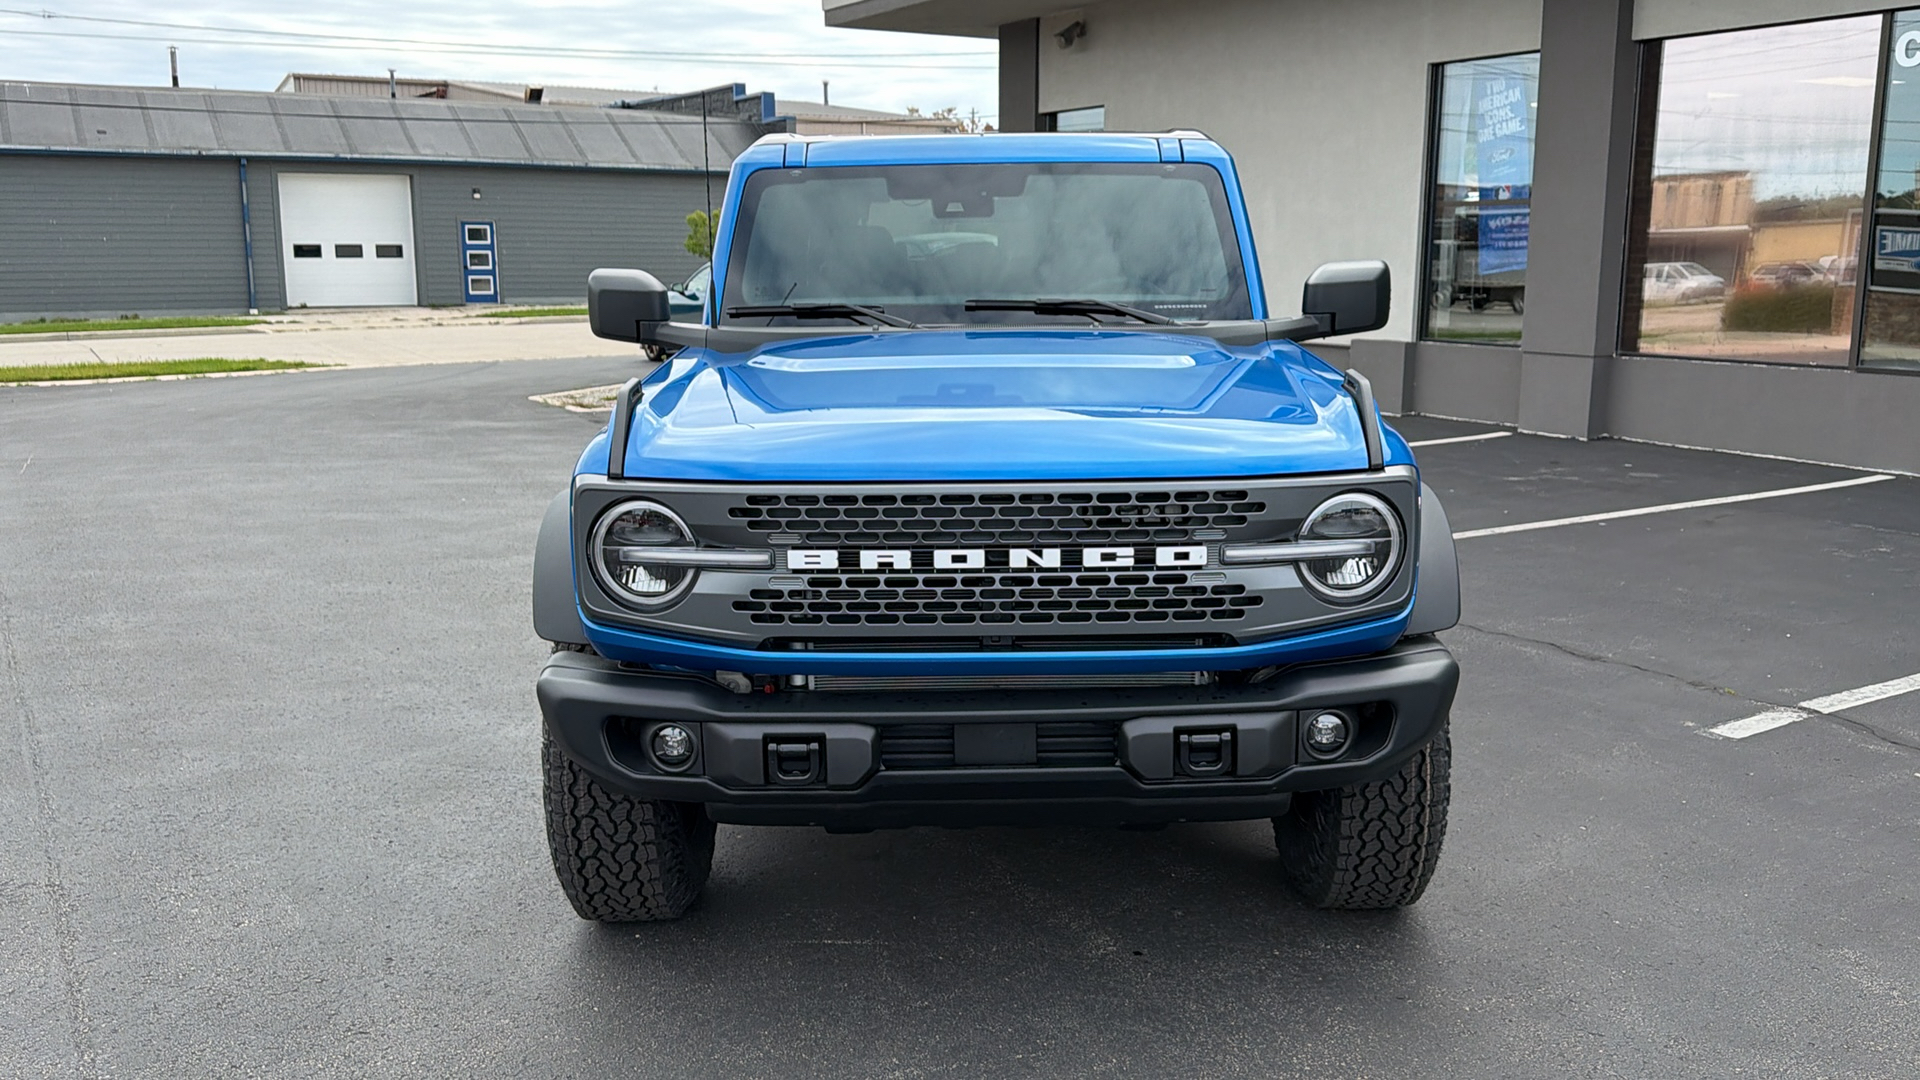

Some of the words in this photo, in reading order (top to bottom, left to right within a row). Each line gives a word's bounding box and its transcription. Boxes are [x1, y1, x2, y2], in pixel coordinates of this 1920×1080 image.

[1486, 79, 1506, 95] TWO
[1478, 86, 1521, 114] AMERICAN
[1484, 105, 1515, 126] ICONS.
[1477, 125, 1495, 143] ONE
[1495, 117, 1525, 137] GAME.
[1491, 148, 1512, 163] Ford
[787, 546, 1208, 570] BRONCO
